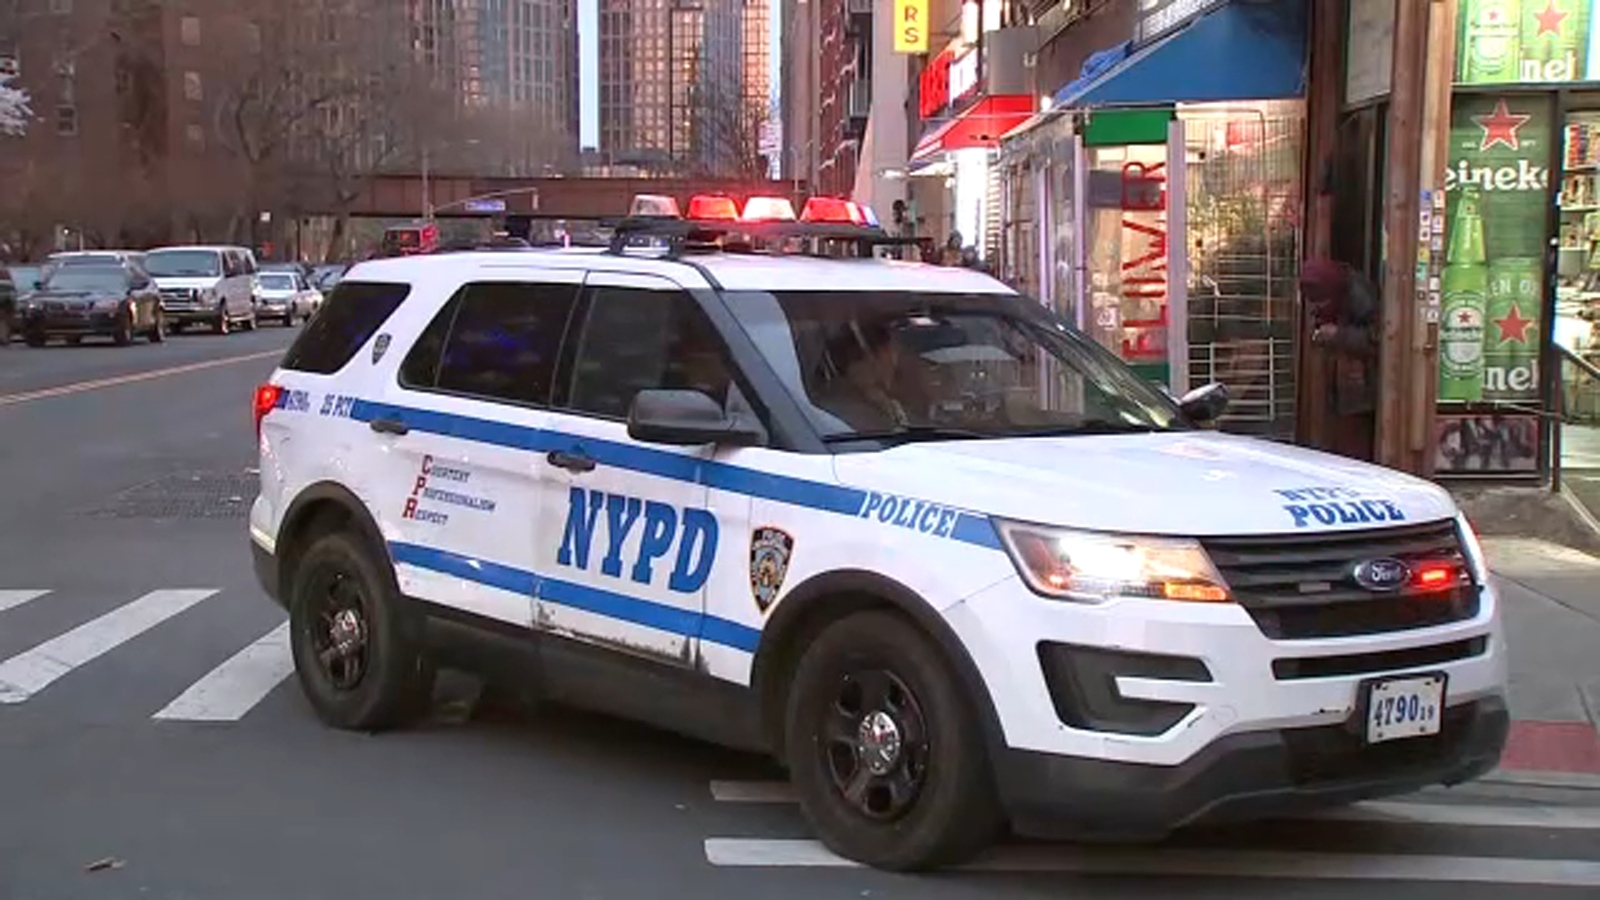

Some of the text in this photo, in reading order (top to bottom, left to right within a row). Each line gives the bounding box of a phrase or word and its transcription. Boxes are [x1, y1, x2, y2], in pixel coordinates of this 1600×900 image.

[861, 491, 956, 538] POLICE
[1282, 499, 1405, 527] POLICE
[557, 486, 719, 593] NYPD
